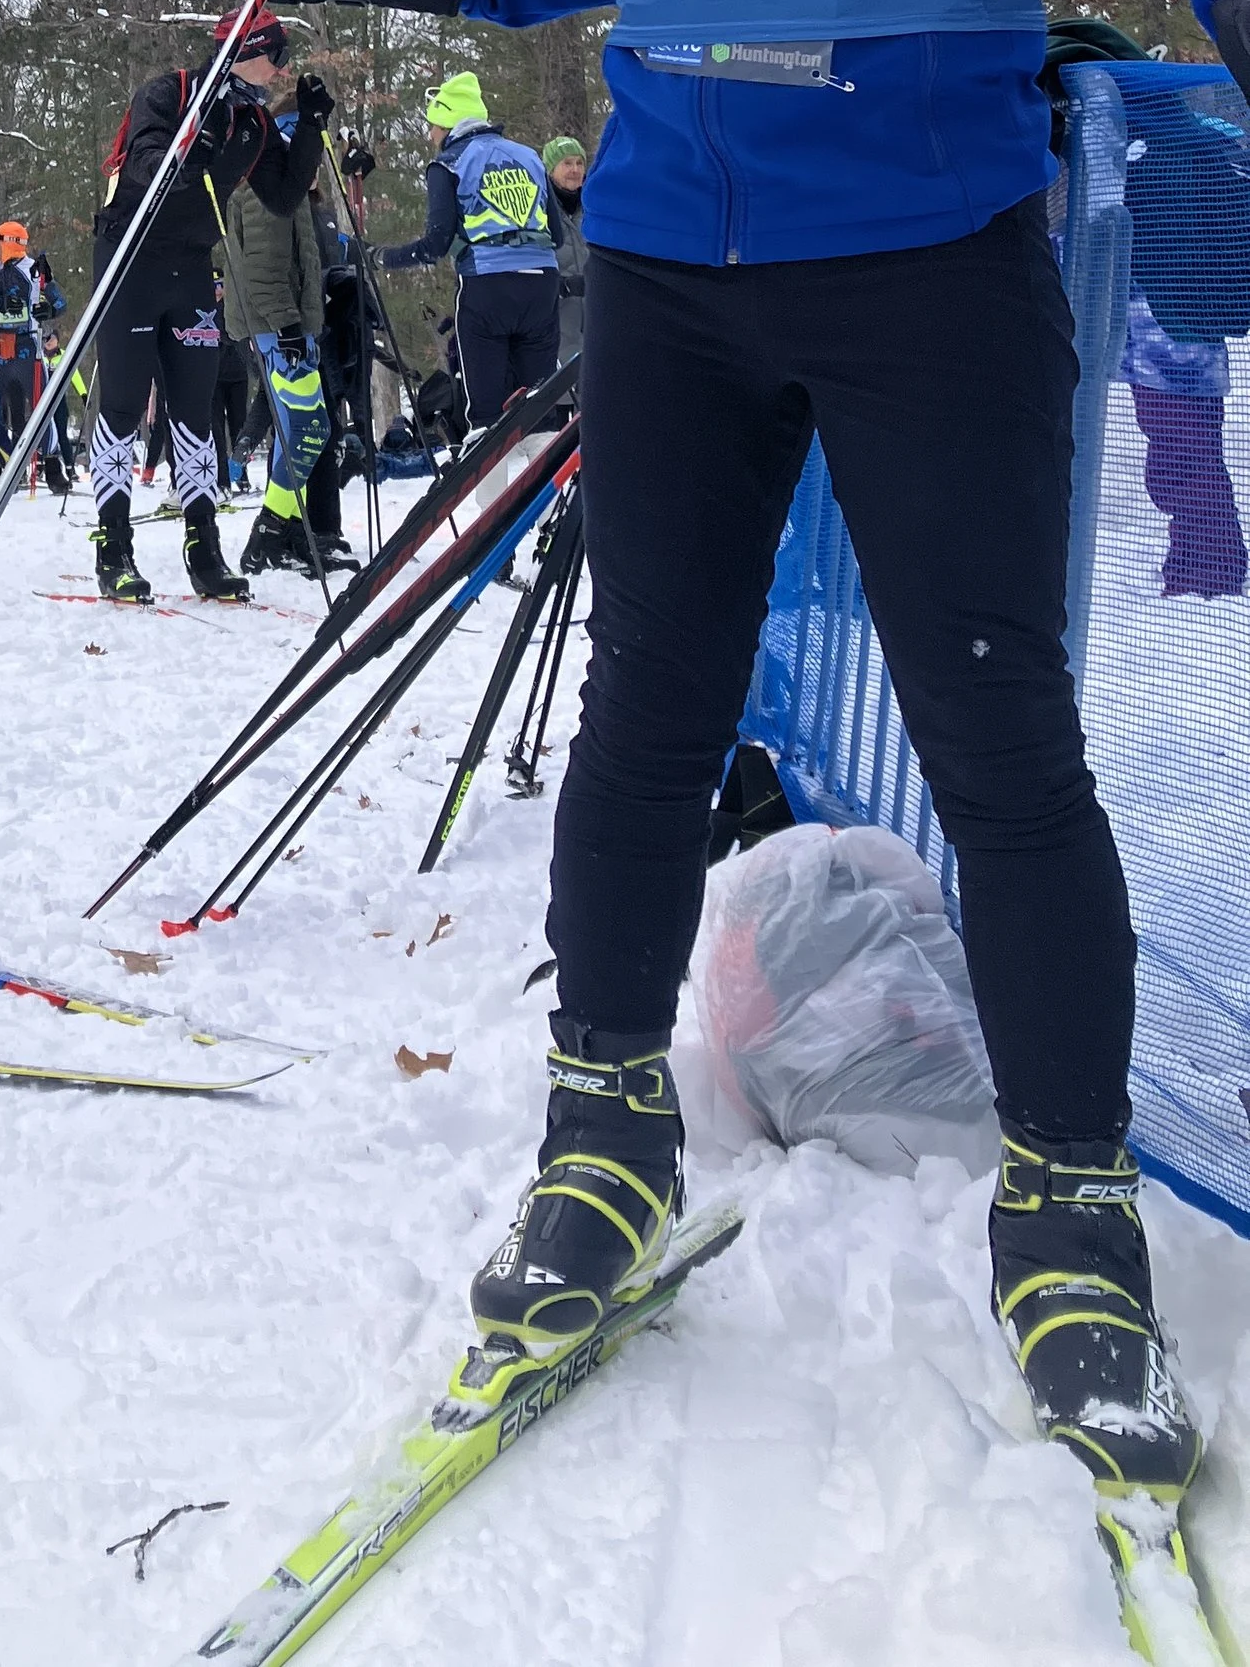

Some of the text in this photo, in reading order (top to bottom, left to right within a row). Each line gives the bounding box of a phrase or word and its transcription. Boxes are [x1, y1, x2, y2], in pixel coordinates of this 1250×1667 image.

[731, 43, 822, 70] Huntington
[483, 168, 531, 190] CRYSTAL
[490, 186, 534, 224] NORDIC
[498, 1334, 605, 1455] FISCHER
